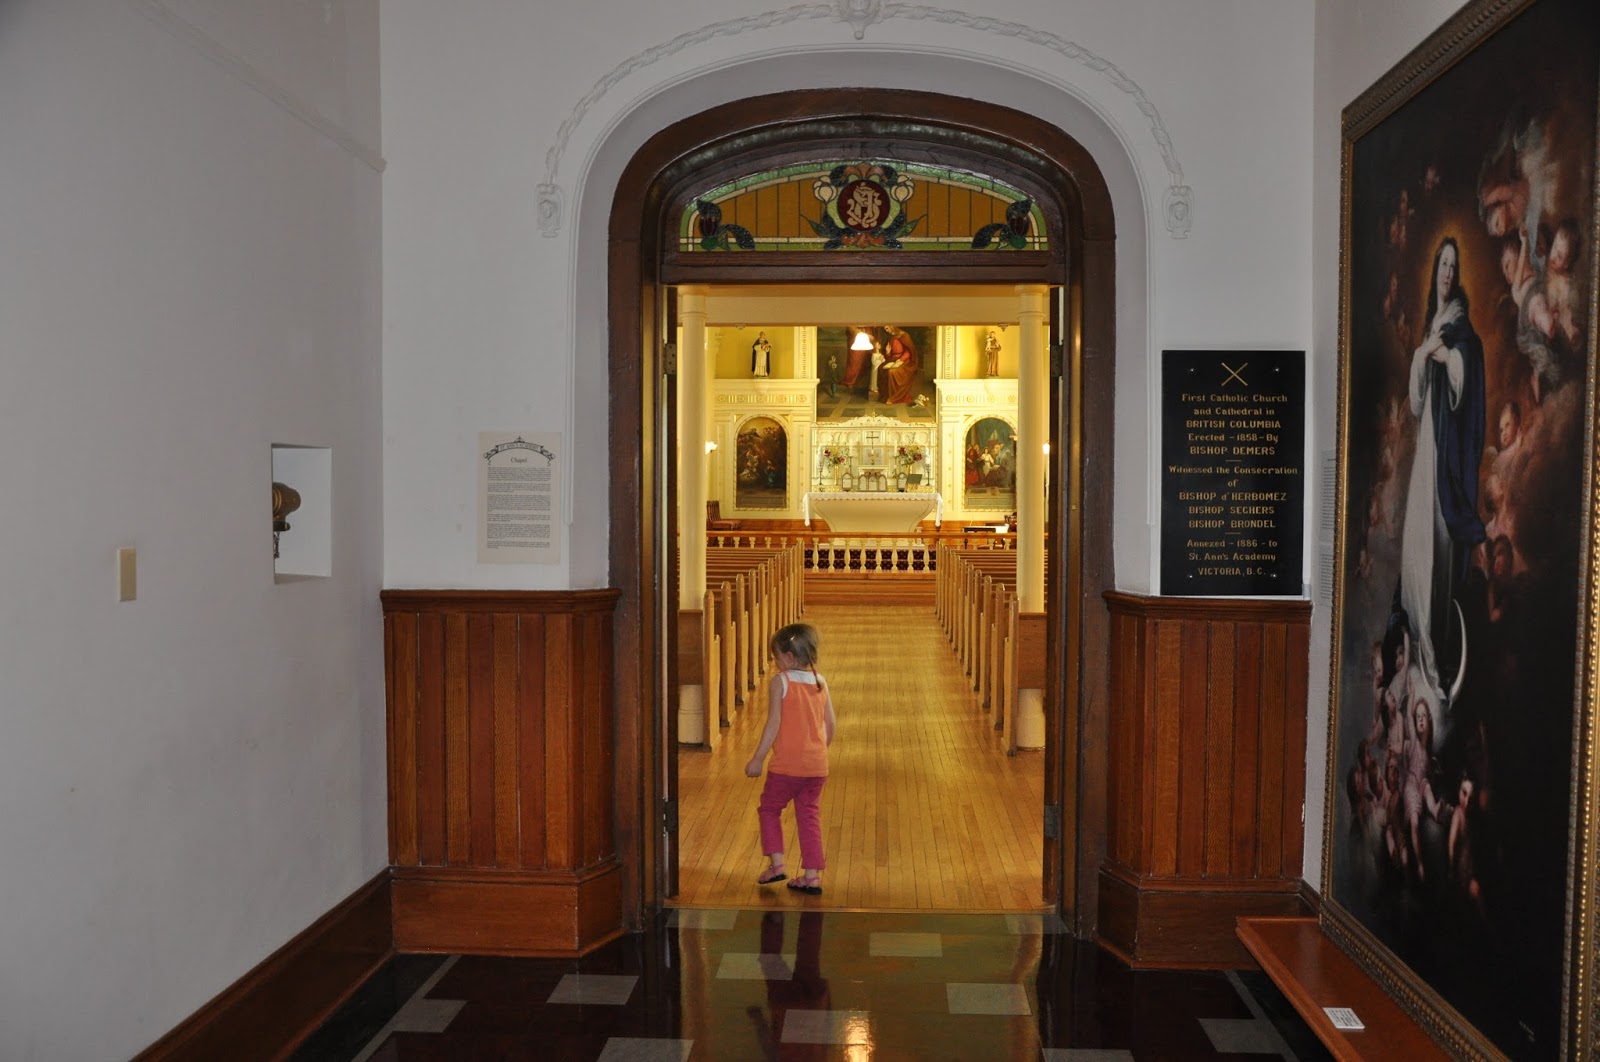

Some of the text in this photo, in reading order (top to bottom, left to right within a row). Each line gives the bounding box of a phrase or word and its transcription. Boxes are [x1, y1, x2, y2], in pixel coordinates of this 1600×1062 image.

[1181, 393, 1288, 402] First Catholic Church
[1193, 407, 1275, 415] and Cathedral in
[1186, 420, 1281, 428] BRITISH COLUMBIA
[1188, 432, 1225, 441] Erected
[1266, 433, 1279, 443] By
[1189, 446, 1275, 455] BISHOP DEMERS
[1168, 465, 1298, 474] Witnessed the Consecration
[1227, 479, 1239, 487] of
[1179, 492, 1217, 500] BISHOP
[1188, 506, 1224, 514] BISHOP
[1188, 520, 1276, 528] BISHOP BRONDEL
[1187, 539, 1226, 548] Annexed
[1268, 540, 1278, 548] to
[1204, 552, 1229, 560] Ann's
[1232, 552, 1276, 562] Academy
